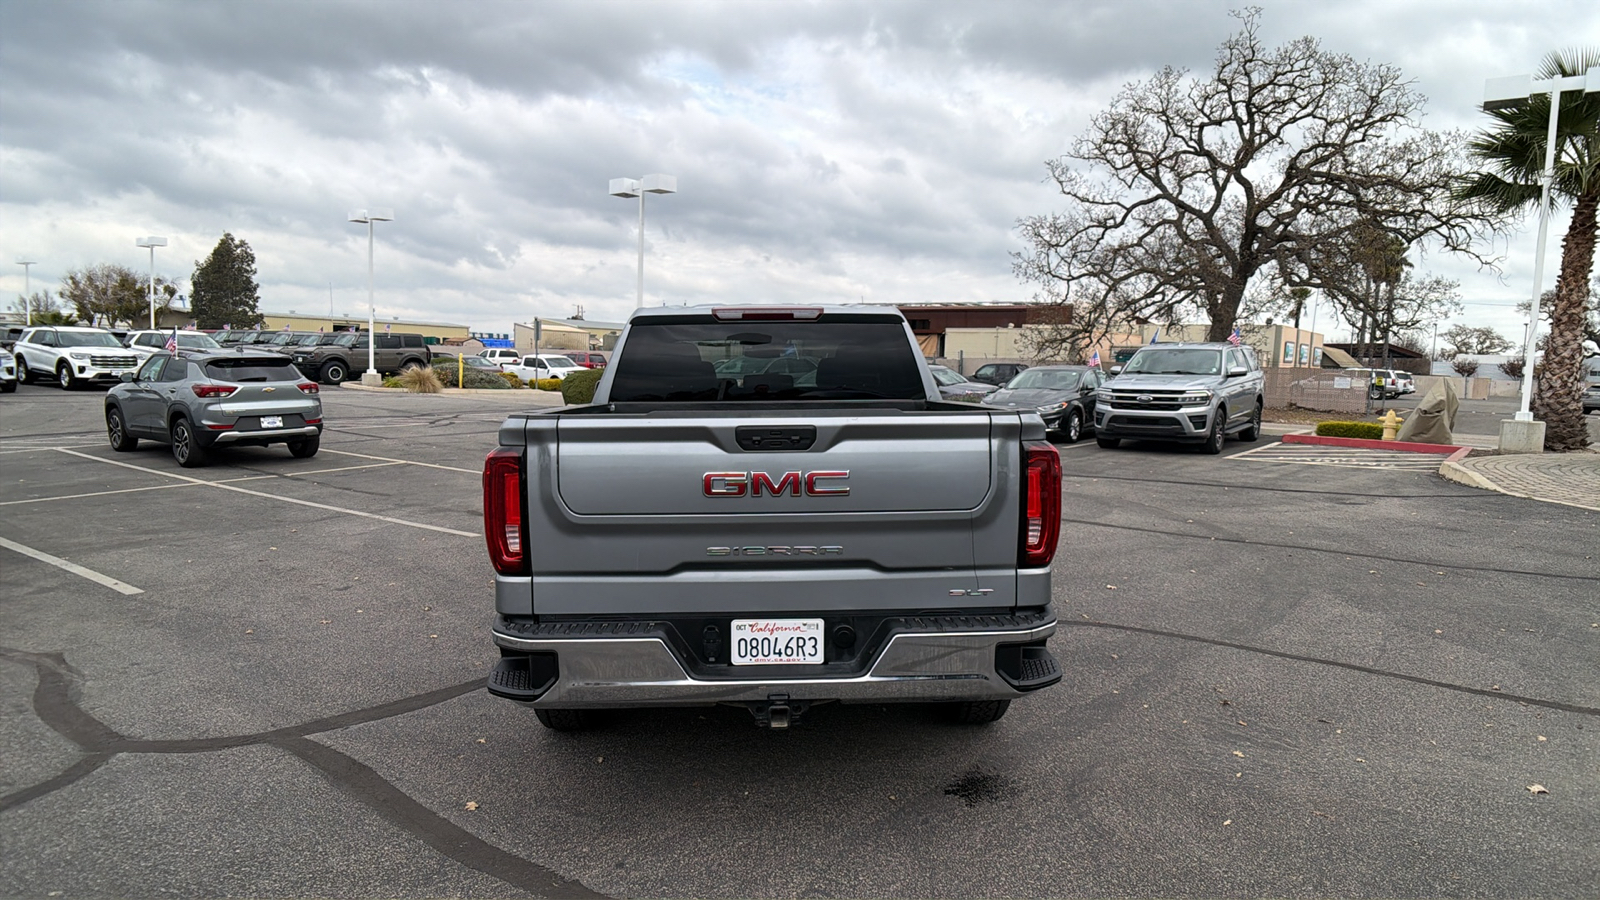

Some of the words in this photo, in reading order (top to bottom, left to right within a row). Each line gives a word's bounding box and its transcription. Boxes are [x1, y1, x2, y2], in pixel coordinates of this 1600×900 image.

[702, 469, 851, 498] GMC
[706, 545, 844, 557] SIERRA
[949, 588, 995, 597] SLT
[750, 622, 807, 636] California
[738, 636, 818, 658] 08046R3
